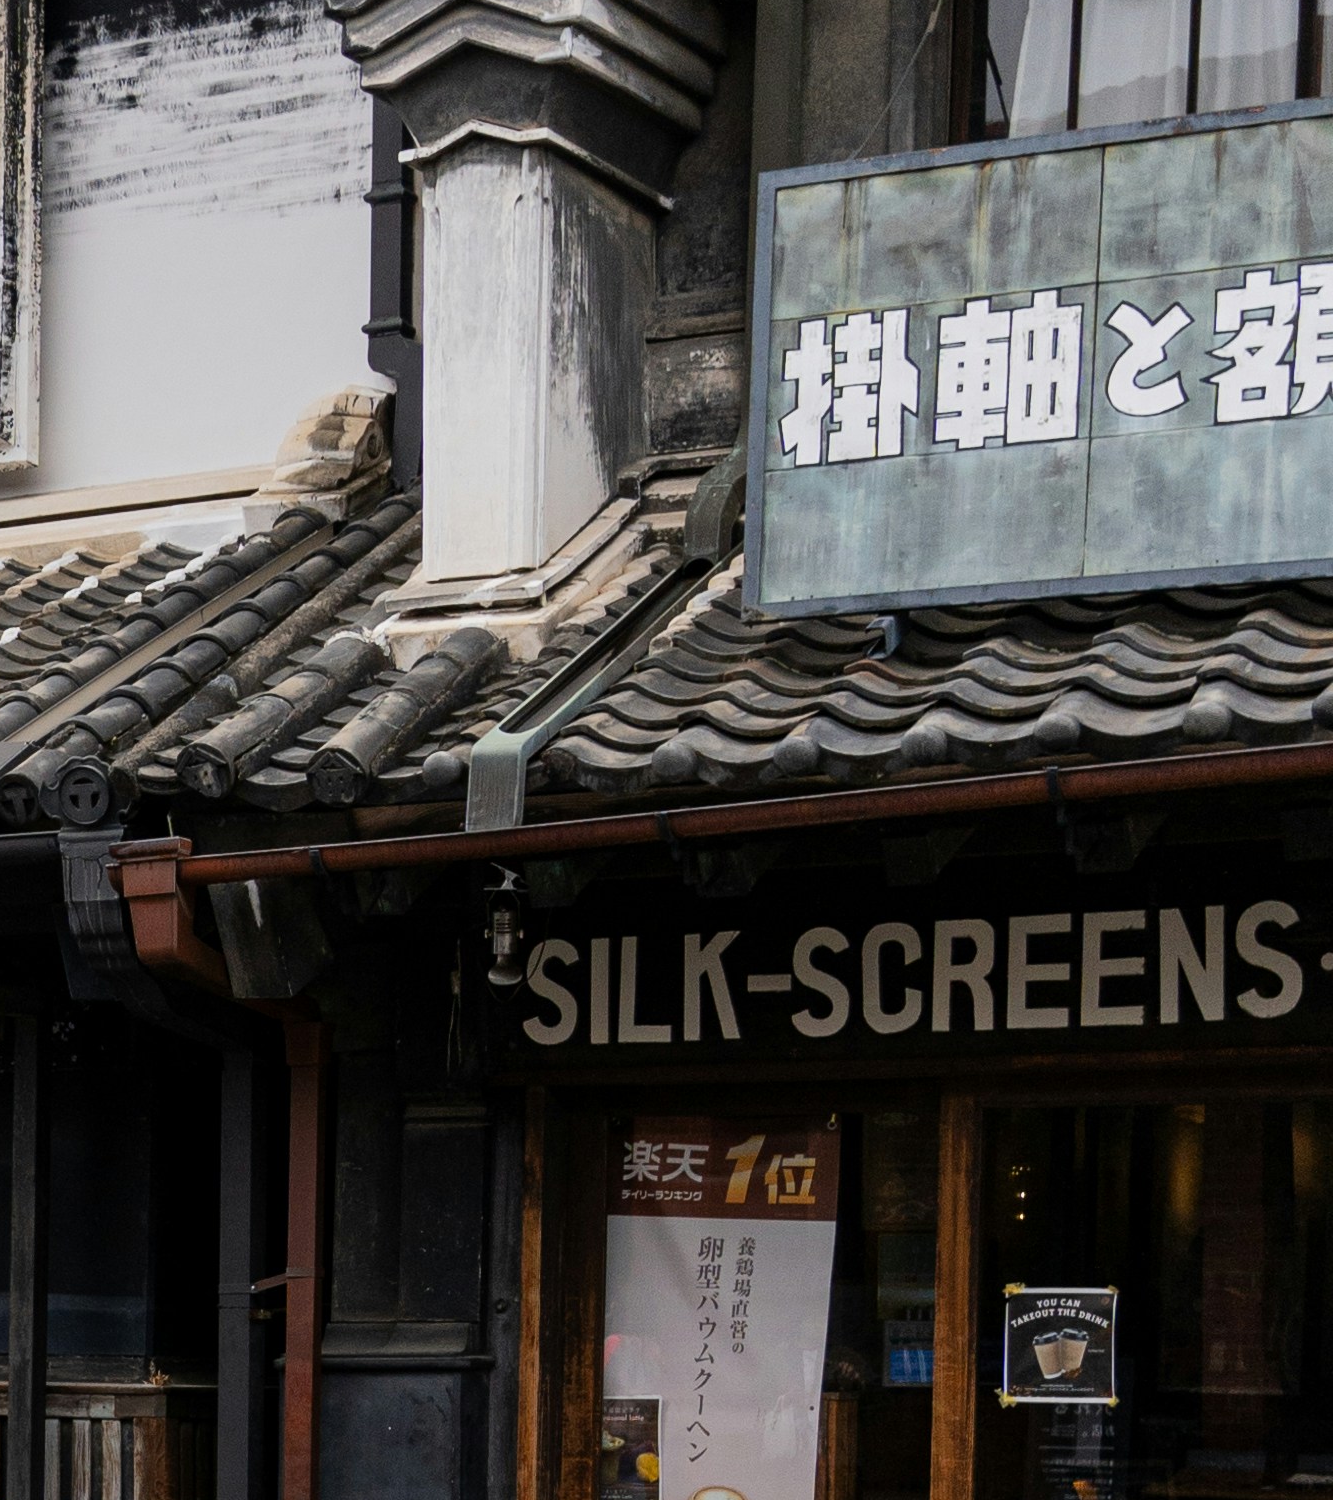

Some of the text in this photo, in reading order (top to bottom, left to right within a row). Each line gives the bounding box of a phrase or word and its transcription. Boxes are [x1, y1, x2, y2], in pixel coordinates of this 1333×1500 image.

[622, 1140, 709, 1183] 楽天
[725, 1134, 817, 1204] 1位
[1011, 1308, 1110, 1329] TAKEOUT THE DRINK
[1037, 1298, 1081, 1308] YOU CAN
[686, 1235, 725, 1463] 卵型バウムクーヘン
